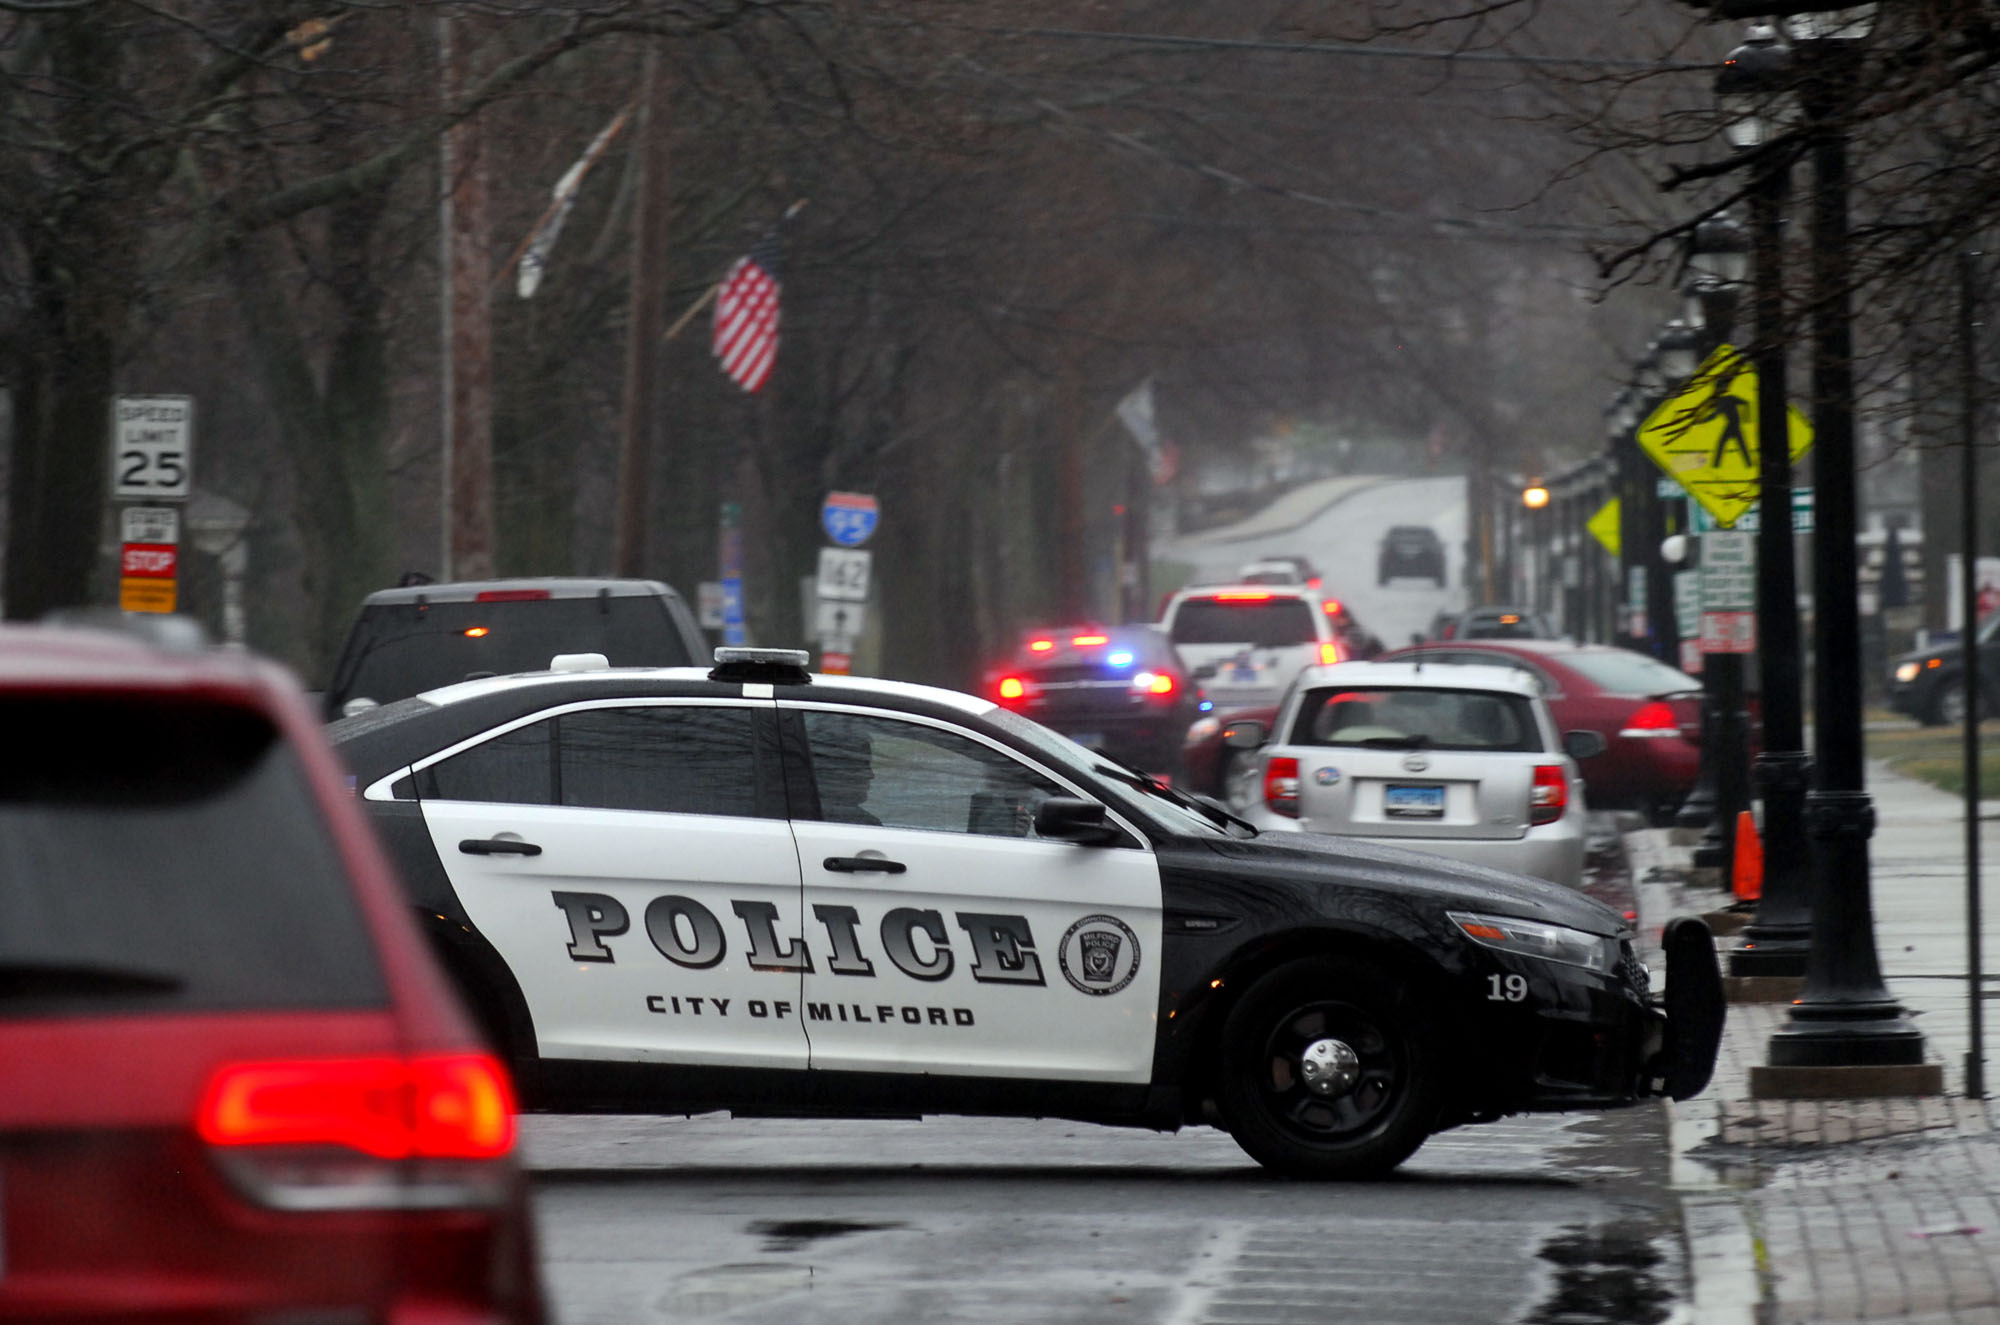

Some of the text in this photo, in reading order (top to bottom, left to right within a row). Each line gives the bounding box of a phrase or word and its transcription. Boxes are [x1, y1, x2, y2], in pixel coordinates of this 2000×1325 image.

[119, 407, 183, 422] SPEED
[125, 429, 178, 443] LIMIT
[120, 450, 184, 488] 25
[124, 551, 175, 571] STOP
[551, 890, 1046, 987] POLICE
[1083, 932, 1120, 944] MILFORD
[1487, 973, 1528, 1002] 19
[646, 994, 975, 1027] CITY OF MILFORD
